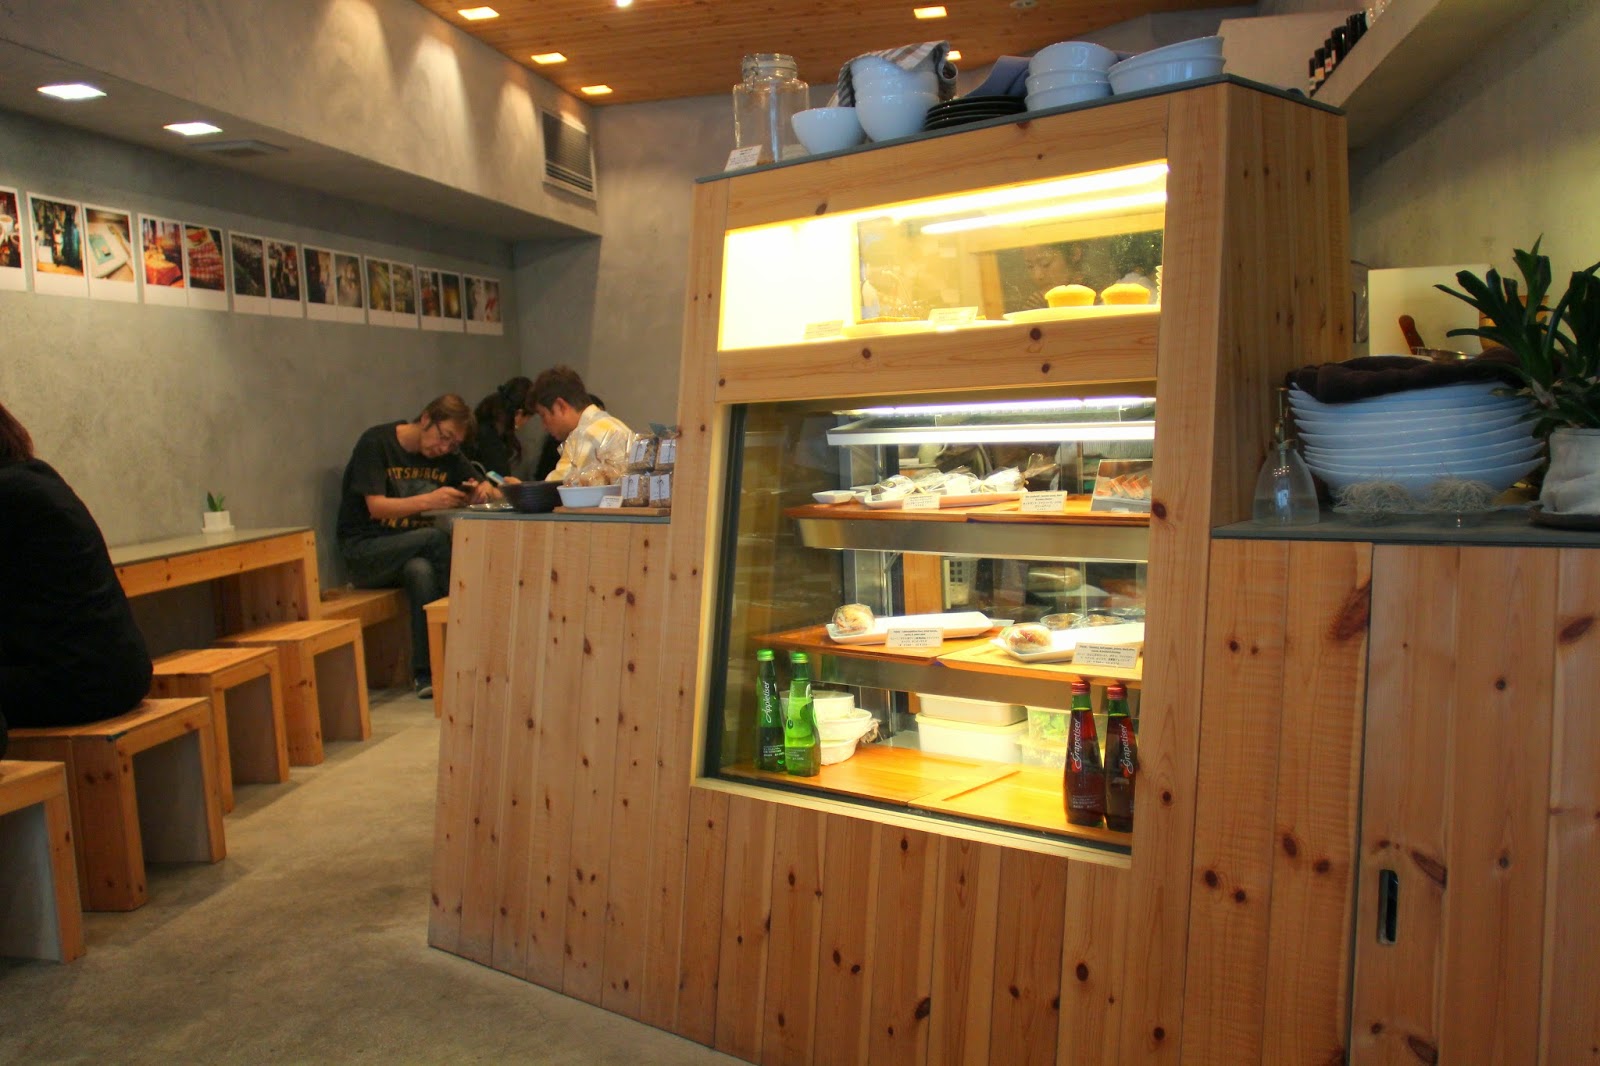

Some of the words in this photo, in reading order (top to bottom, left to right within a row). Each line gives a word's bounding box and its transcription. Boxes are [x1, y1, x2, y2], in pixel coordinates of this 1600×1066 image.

[761, 680, 772, 724] Appletiser
[1071, 718, 1082, 769] Grapetiser
[1119, 724, 1134, 775] Grapetiser
